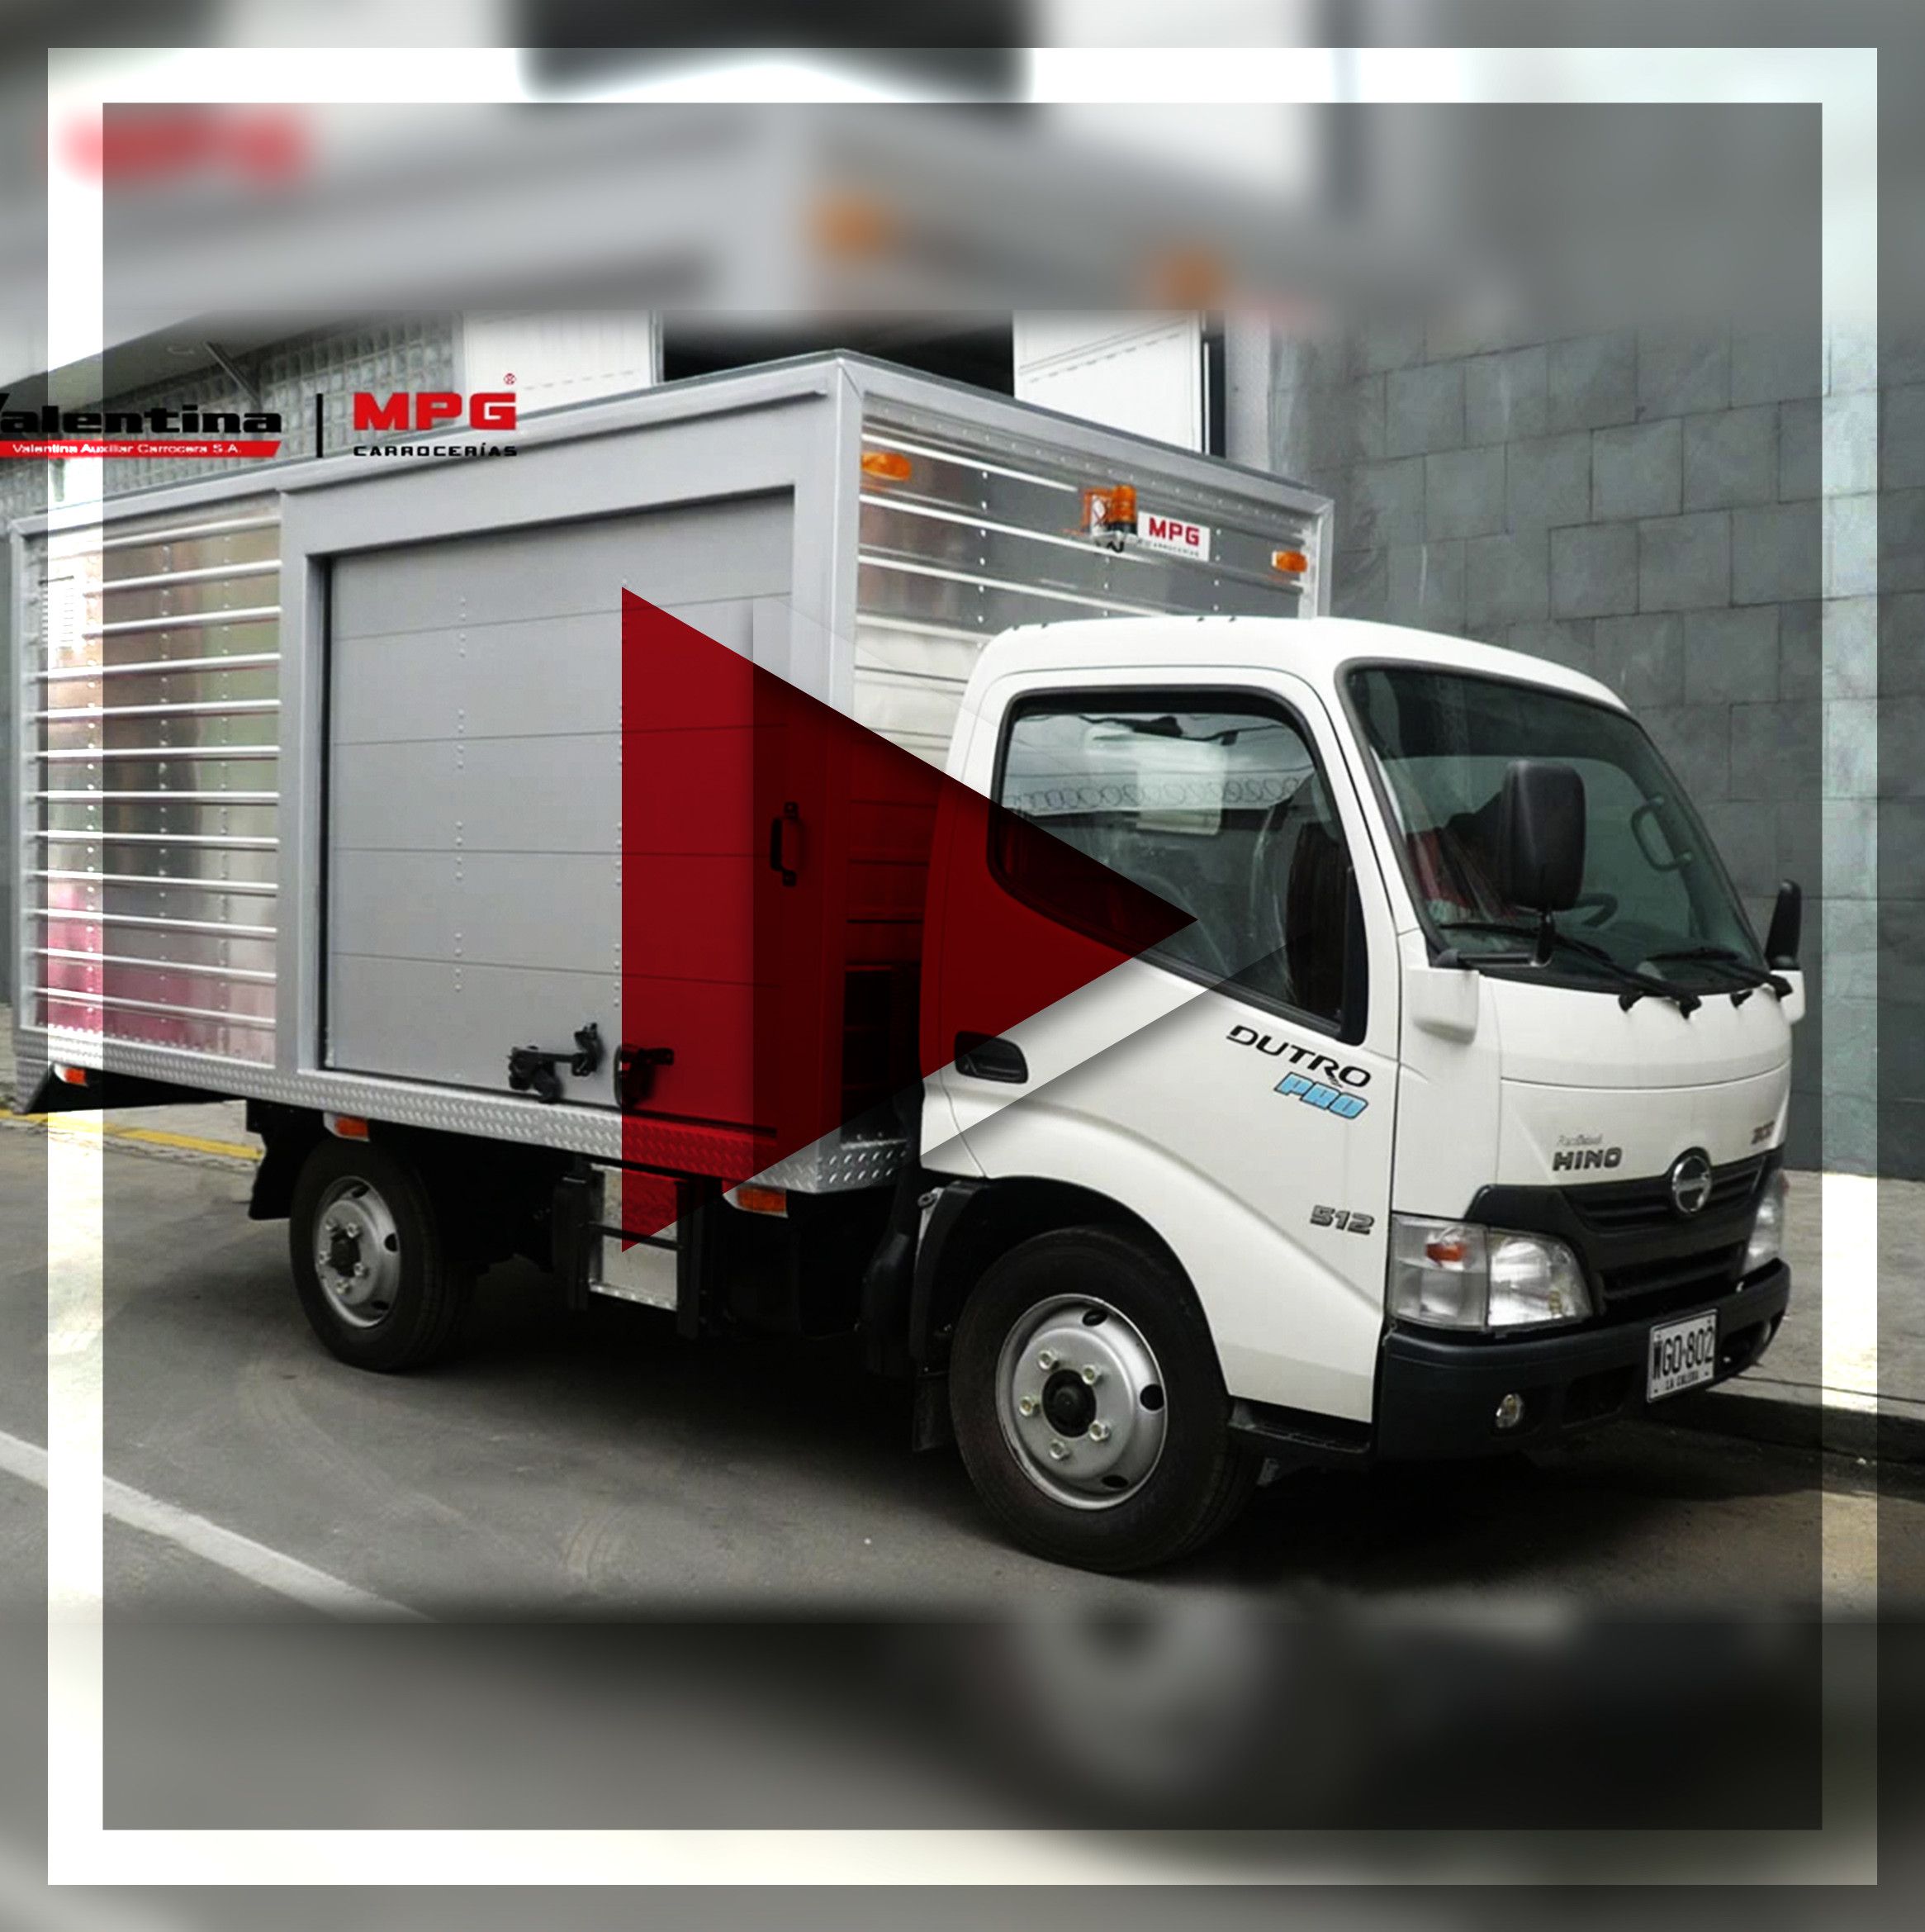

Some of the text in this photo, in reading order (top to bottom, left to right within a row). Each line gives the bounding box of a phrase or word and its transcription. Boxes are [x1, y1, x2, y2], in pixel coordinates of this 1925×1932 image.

[1149, 517, 1200, 547] MPG
[1226, 1025, 1371, 1088] DUTRO
[1273, 1071, 1368, 1119] PRO
[1553, 1146, 1622, 1171] HINO
[1310, 1204, 1375, 1235] 512
